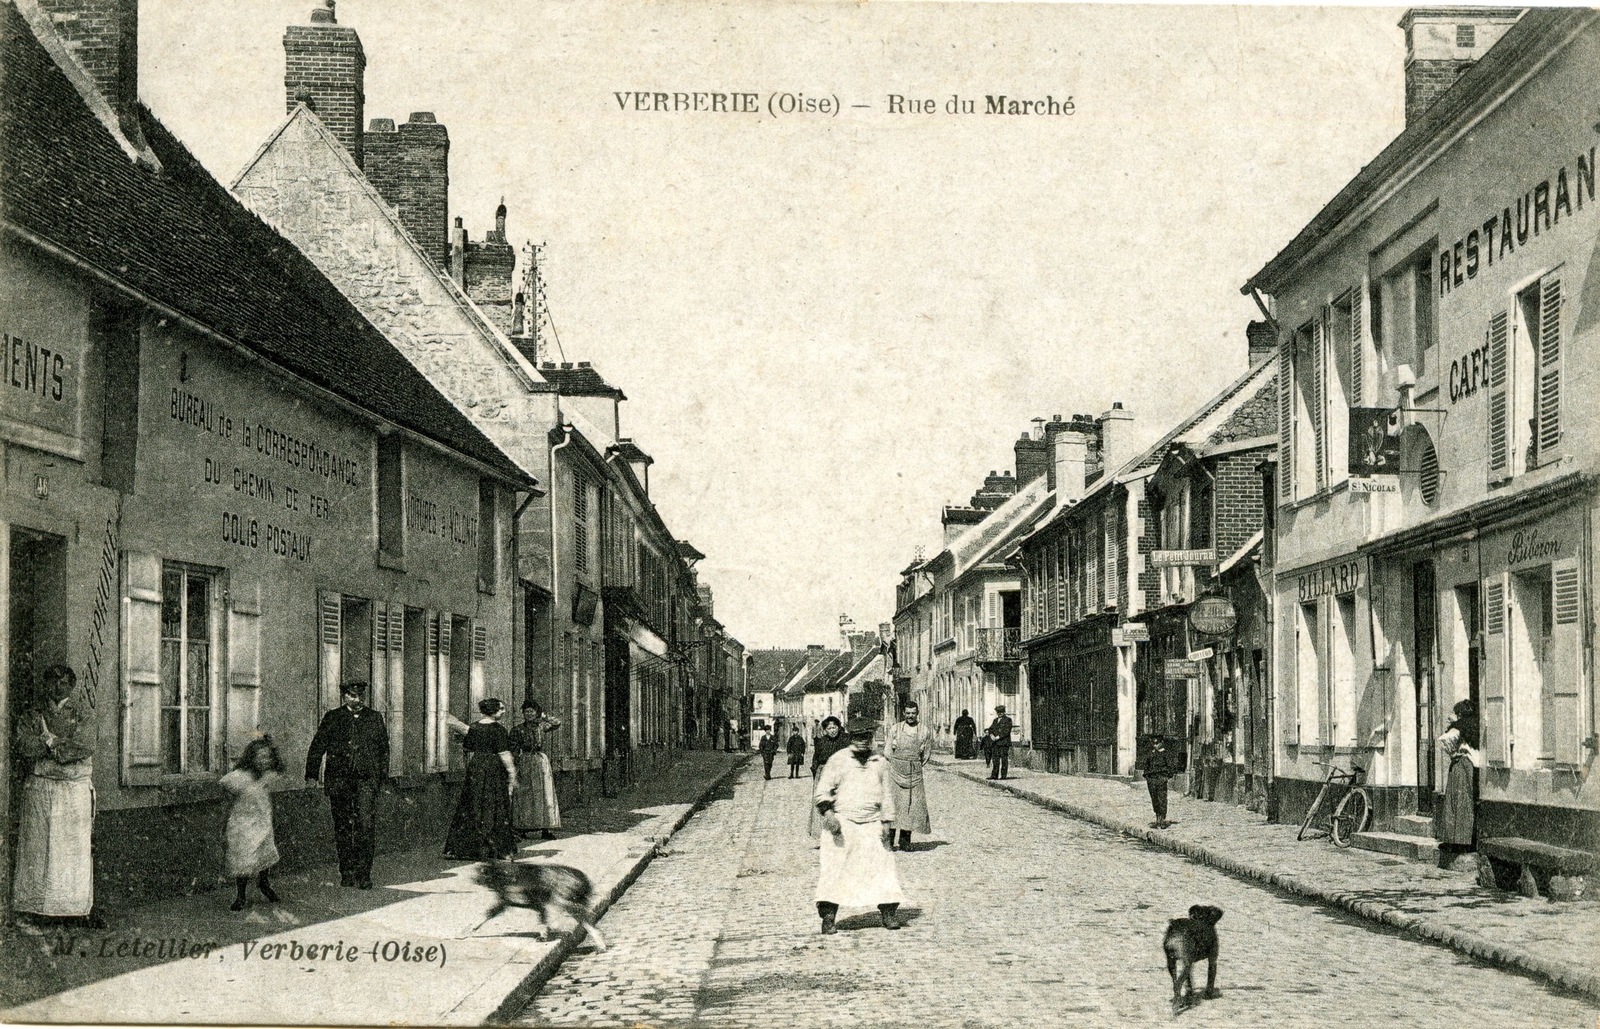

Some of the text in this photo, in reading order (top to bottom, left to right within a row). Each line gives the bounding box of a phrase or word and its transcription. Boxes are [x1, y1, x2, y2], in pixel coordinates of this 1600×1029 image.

[1439, 136, 1600, 298] RESTAURAN
[170, 387, 357, 487] BUREAU de la CORRESPONDANCE
[204, 457, 329, 520] DU CHEMIN DE FER
[222, 511, 312, 563] COLIS POSTAUX
[1153, 549, 1217, 562] Le Petit Journal
[1298, 561, 1359, 602] BILLARD
